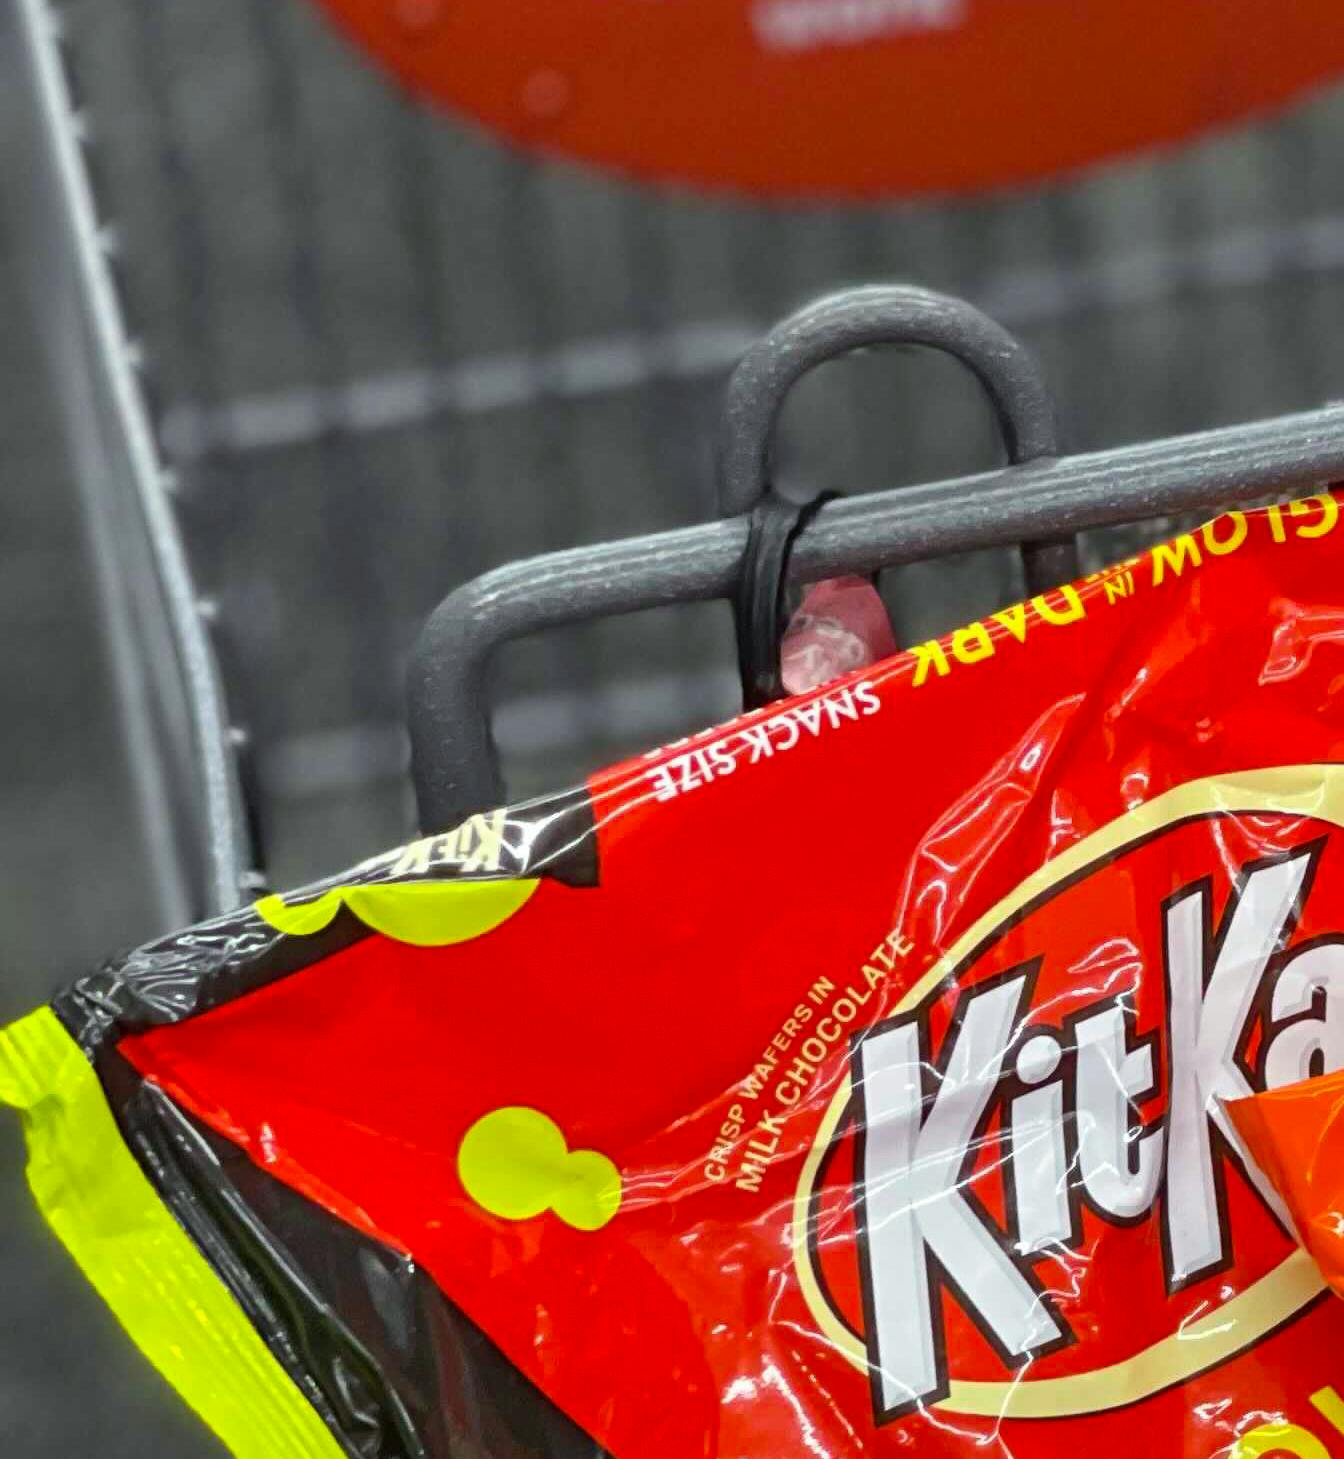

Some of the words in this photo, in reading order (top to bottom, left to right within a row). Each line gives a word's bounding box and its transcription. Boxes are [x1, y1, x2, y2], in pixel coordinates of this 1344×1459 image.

[912, 583, 1088, 686] DARK
[645, 740, 738, 801] SIZE
[742, 679, 882, 765] SNACK
[703, 1103, 747, 1183] CRISP
[740, 1002, 814, 1101] WAFERS
[807, 975, 836, 1005] IN
[735, 1109, 788, 1193] MILK
[774, 925, 916, 1107] CHOCOLATE
